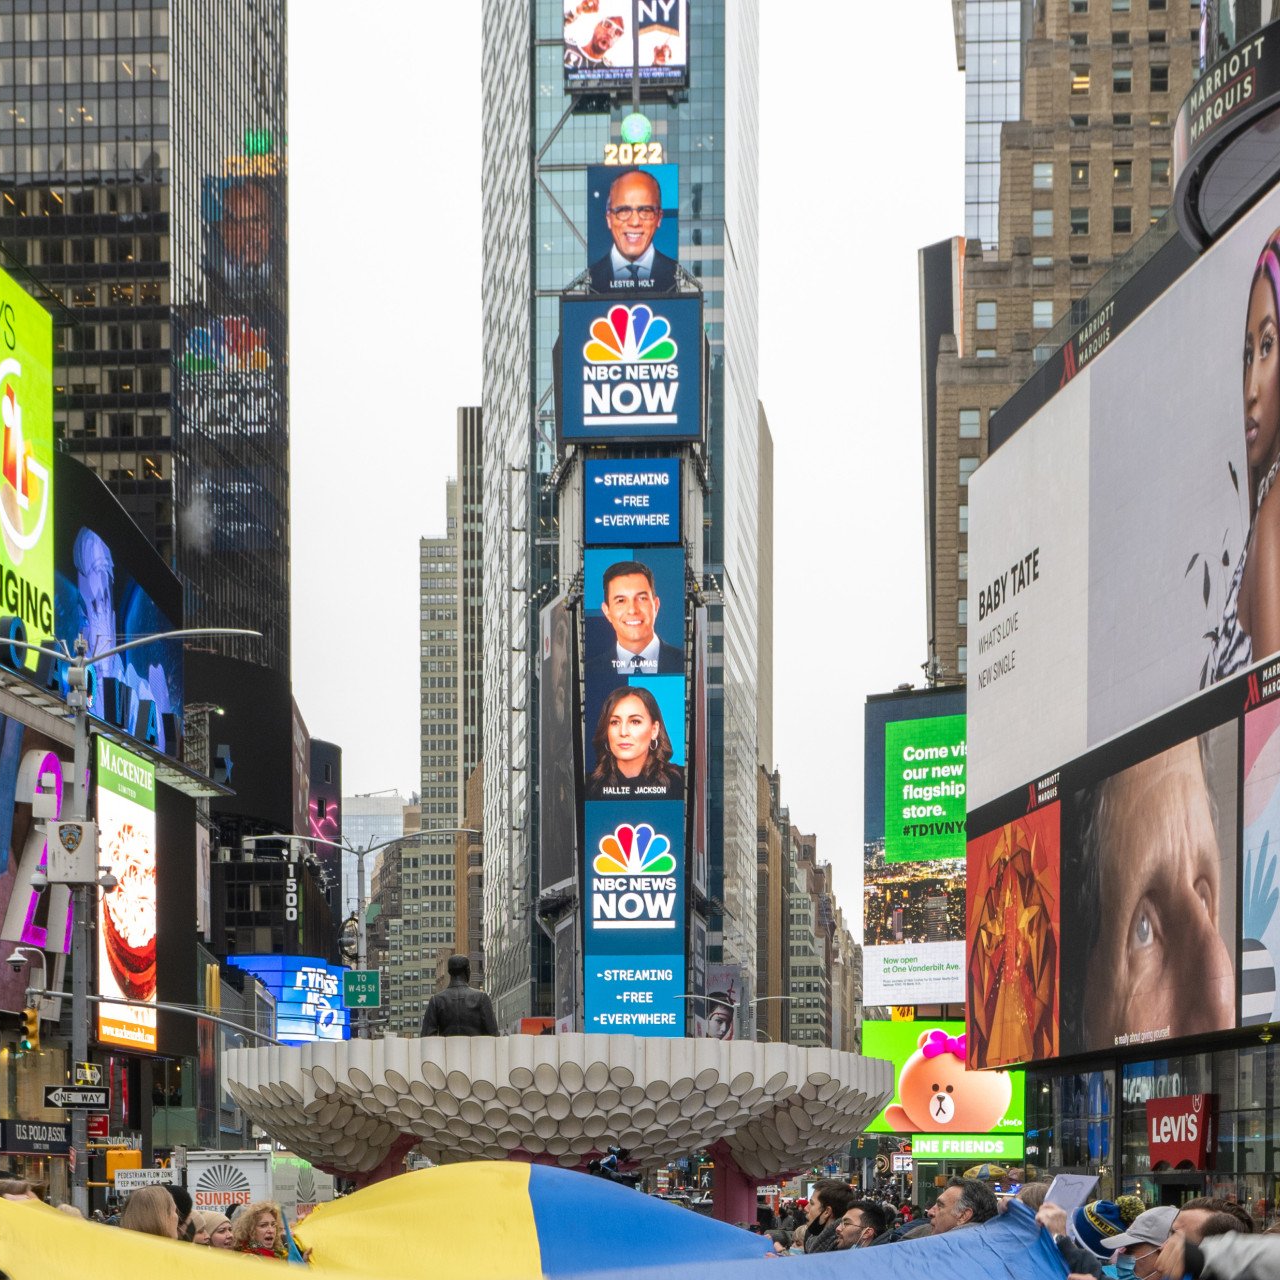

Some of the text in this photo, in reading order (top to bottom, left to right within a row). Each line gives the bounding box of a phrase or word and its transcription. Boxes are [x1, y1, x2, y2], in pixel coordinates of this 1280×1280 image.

[1190, 36, 1265, 115] MARRIOTT
[1190, 75, 1252, 145] MARQUIS
[604, 142, 663, 166] 2022
[610, 279, 656, 288] LESTER HOLT
[1078, 301, 1115, 347] MARRIOTT
[1078, 326, 1111, 367] MARQUIS
[583, 364, 679, 381] NBC NEWS
[583, 382, 679, 415] NOW
[604, 473, 669, 486] STREAMING
[623, 495, 650, 507] FREE
[602, 513, 670, 527] EVERYWHERE
[978, 547, 1040, 622] BABY TATE
[978, 612, 1019, 656] WHAT'S LOVE
[611, 660, 626, 668] TOM
[978, 650, 1016, 691] NEW SINGLE
[903, 744, 949, 762] Come
[100, 741, 153, 792] MACKENZIE
[902, 764, 963, 781] our new
[902, 780, 966, 800] flagship
[1037, 772, 1061, 792] MARRIOTT
[118, 783, 137, 799] LIMITED
[603, 786, 667, 795] HALLIE JACKSON
[1037, 787, 1058, 804] MARQUIS
[902, 804, 947, 820] store.
[285, 863, 298, 921] 1500
[592, 877, 677, 891] NBC NEWS
[592, 892, 677, 919] NOW
[883, 956, 918, 967] Now open
[883, 961, 961, 973] at One Vanderbilt Ave.
[357, 974, 367, 982] TO
[603, 969, 673, 981] STREAMING
[622, 991, 654, 1003] FREE
[600, 1013, 677, 1025] EVERYWHERE
[53, 1093, 101, 1103] ONE WAY
[15, 1124, 48, 1142] U.S. POLO
[942, 1140, 1005, 1154] FRIENDS
[161, 1170, 174, 1178] ZONE
[195, 1191, 251, 1206] SUNRISE
